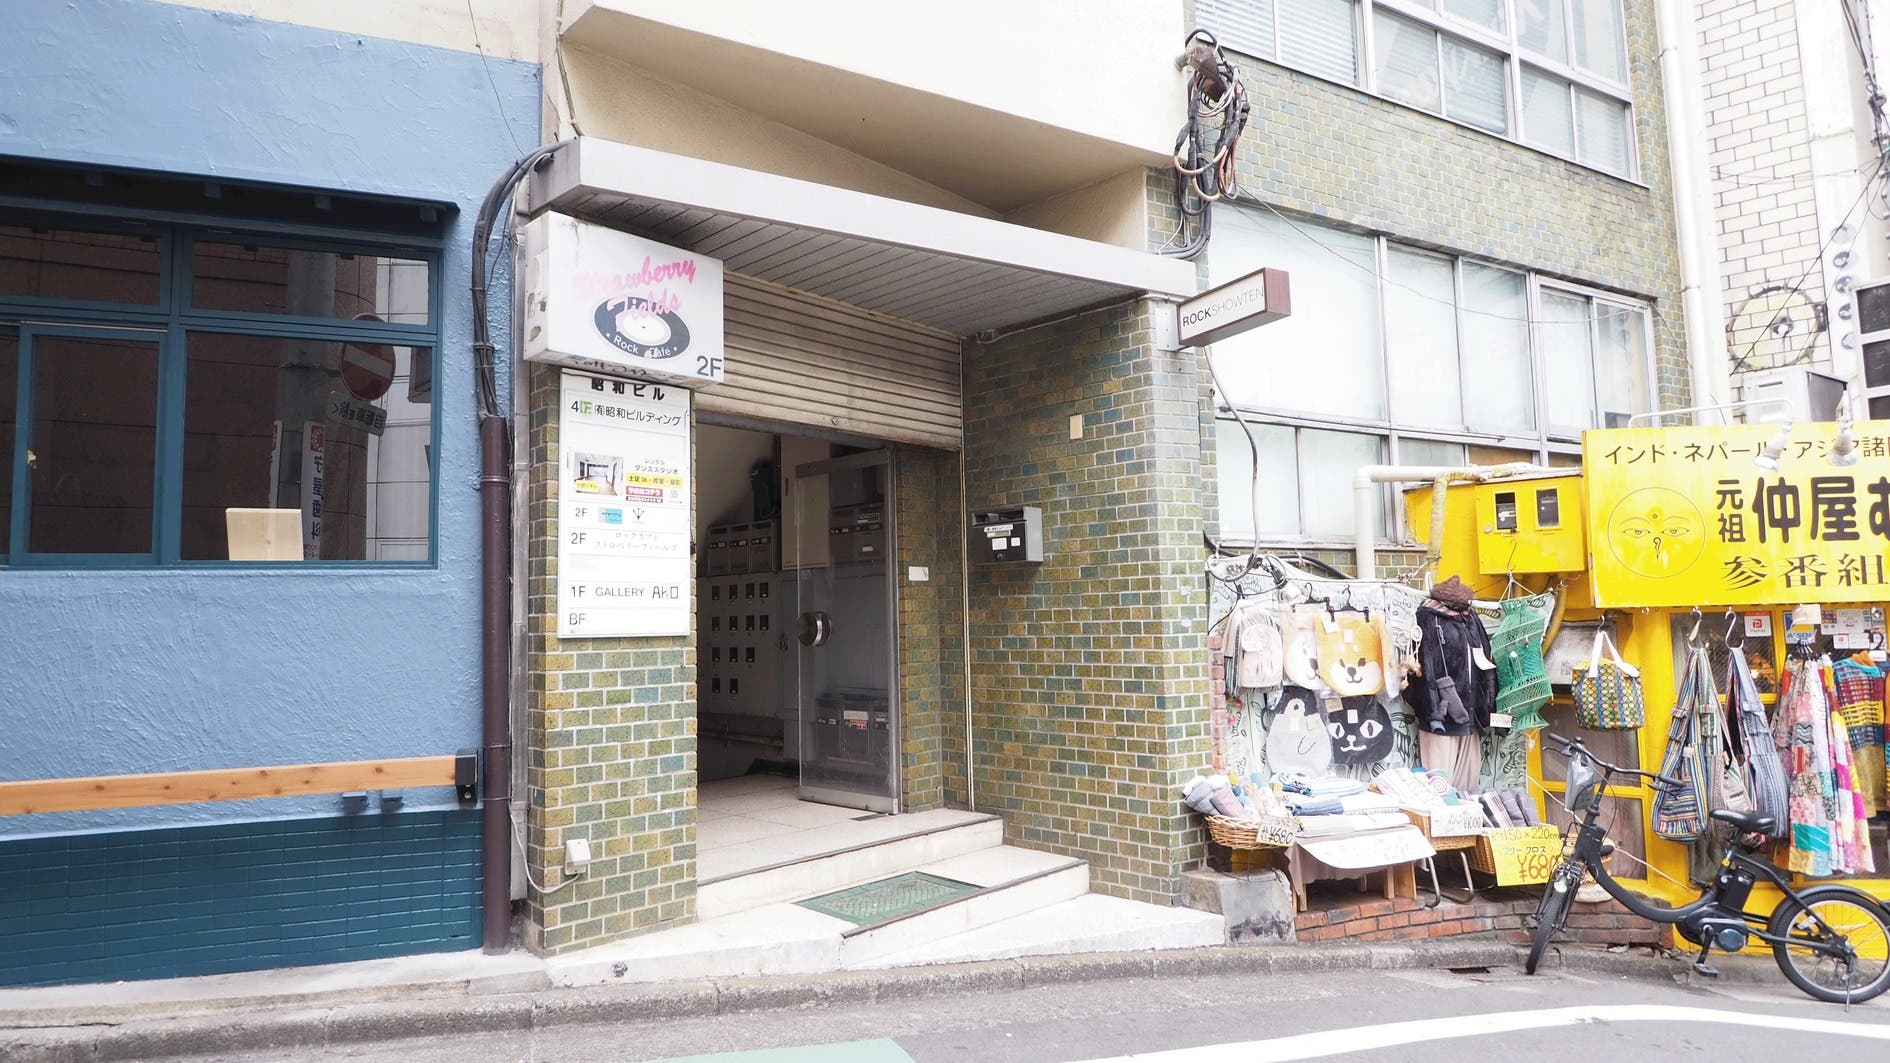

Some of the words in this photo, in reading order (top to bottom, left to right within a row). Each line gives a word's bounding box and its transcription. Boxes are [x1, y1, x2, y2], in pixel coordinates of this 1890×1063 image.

[1182, 287, 1264, 327] ROCKSHOWTEN
[613, 335, 639, 355] Rock
[696, 355, 722, 377] 2F
[591, 378, 665, 401] 昭和ビル
[575, 508, 588, 517] 2F
[1716, 479, 1746, 543] 元祖
[571, 533, 587, 545] 2F
[1721, 553, 1889, 592] 参番組
[571, 586, 586, 598] 1F
[595, 587, 644, 597] GALLERY
[569, 613, 586, 625] BF
